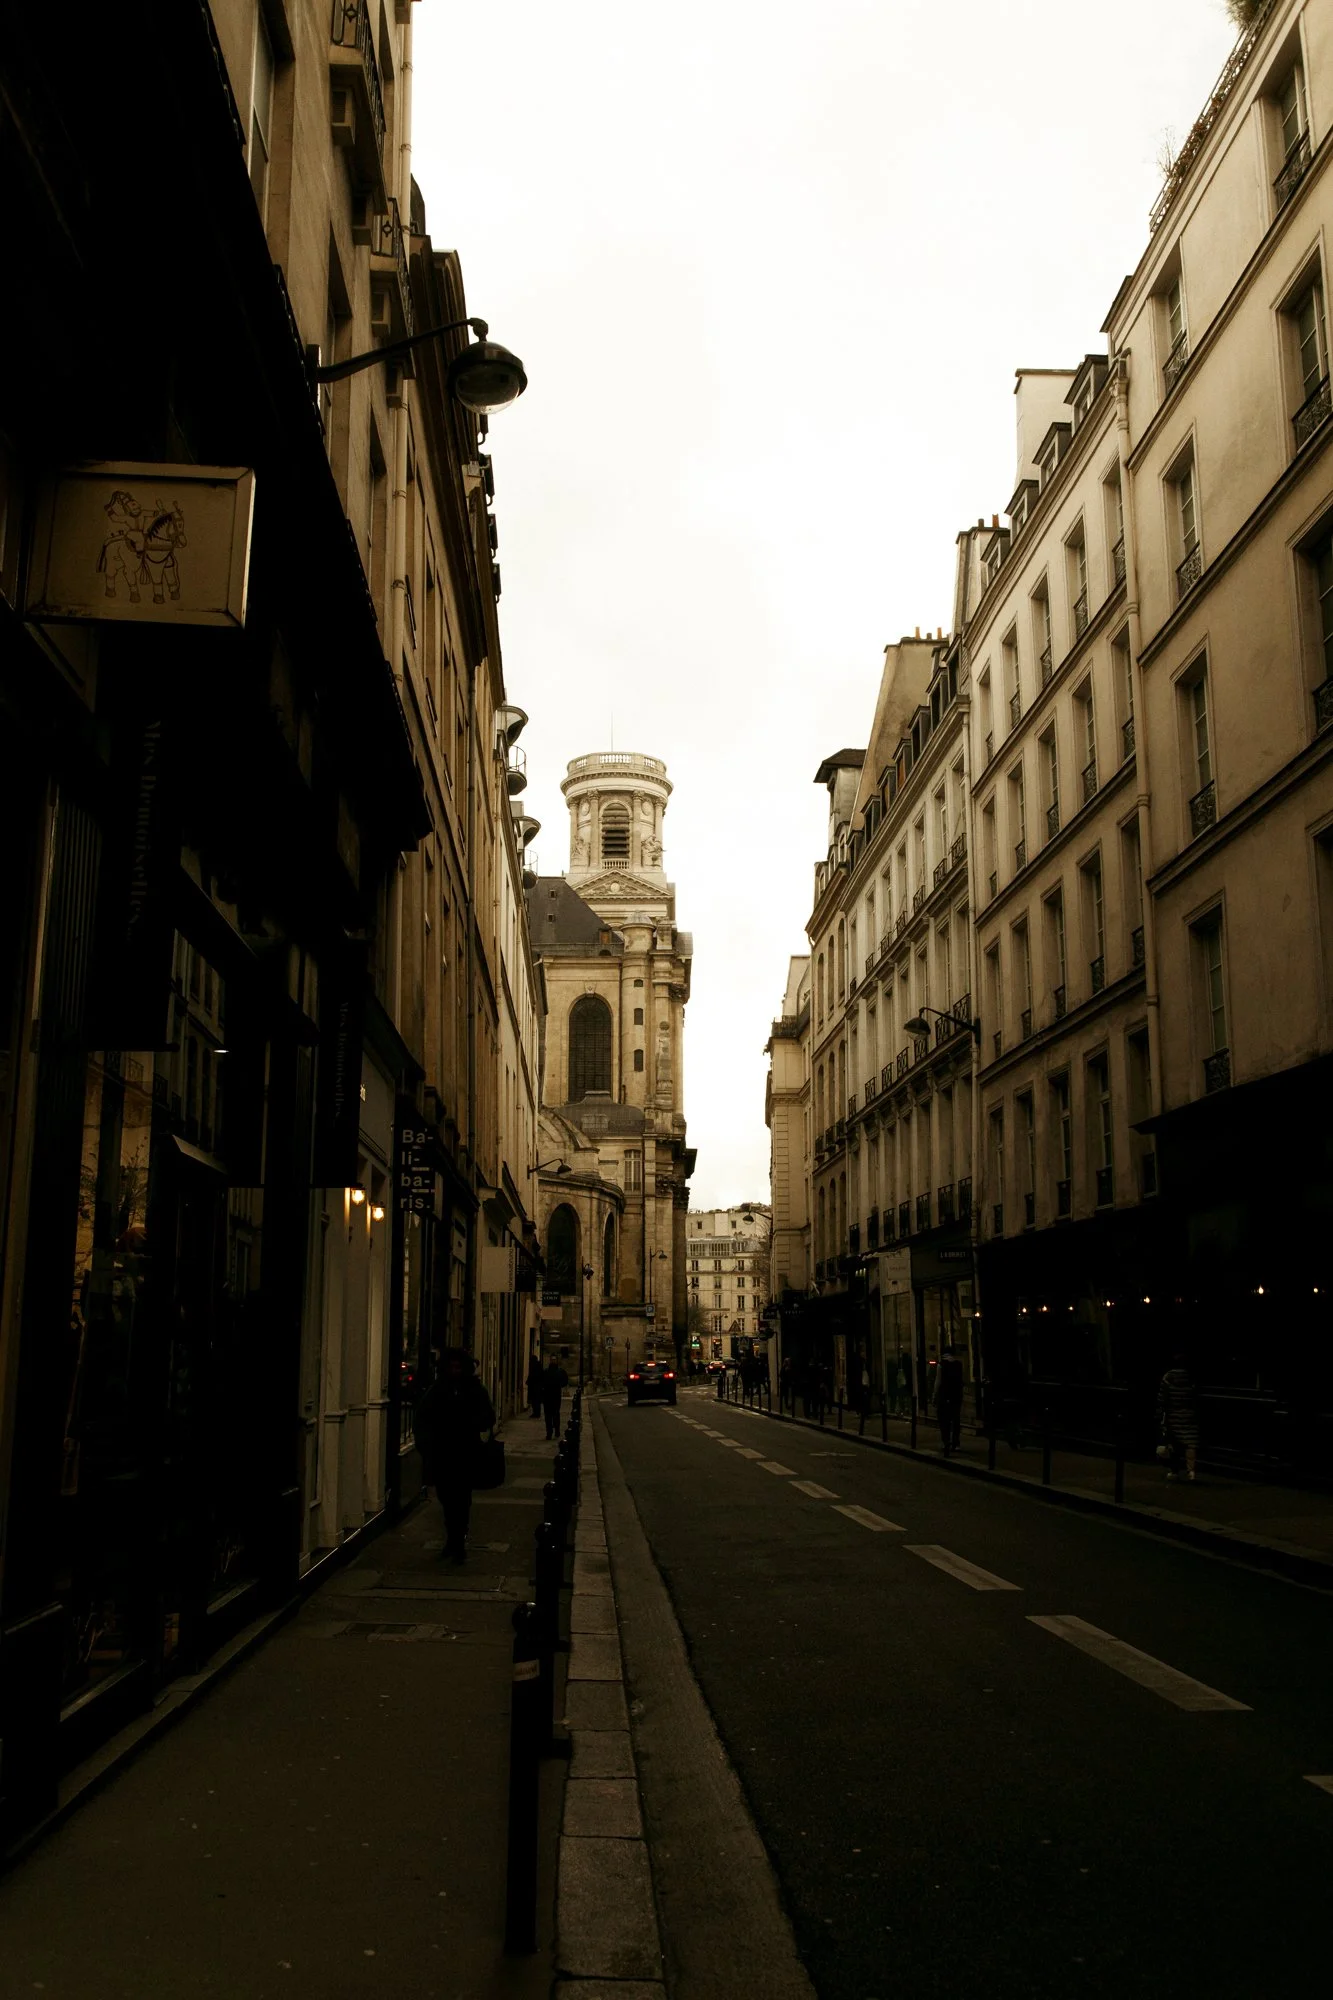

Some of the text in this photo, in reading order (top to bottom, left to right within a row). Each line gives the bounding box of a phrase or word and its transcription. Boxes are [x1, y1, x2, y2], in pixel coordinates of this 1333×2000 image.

[141, 720, 161, 766] Mes
[401, 1151, 420, 1166] li-
[400, 1171, 431, 1187] ba-
[400, 1194, 431, 1209] ris.
